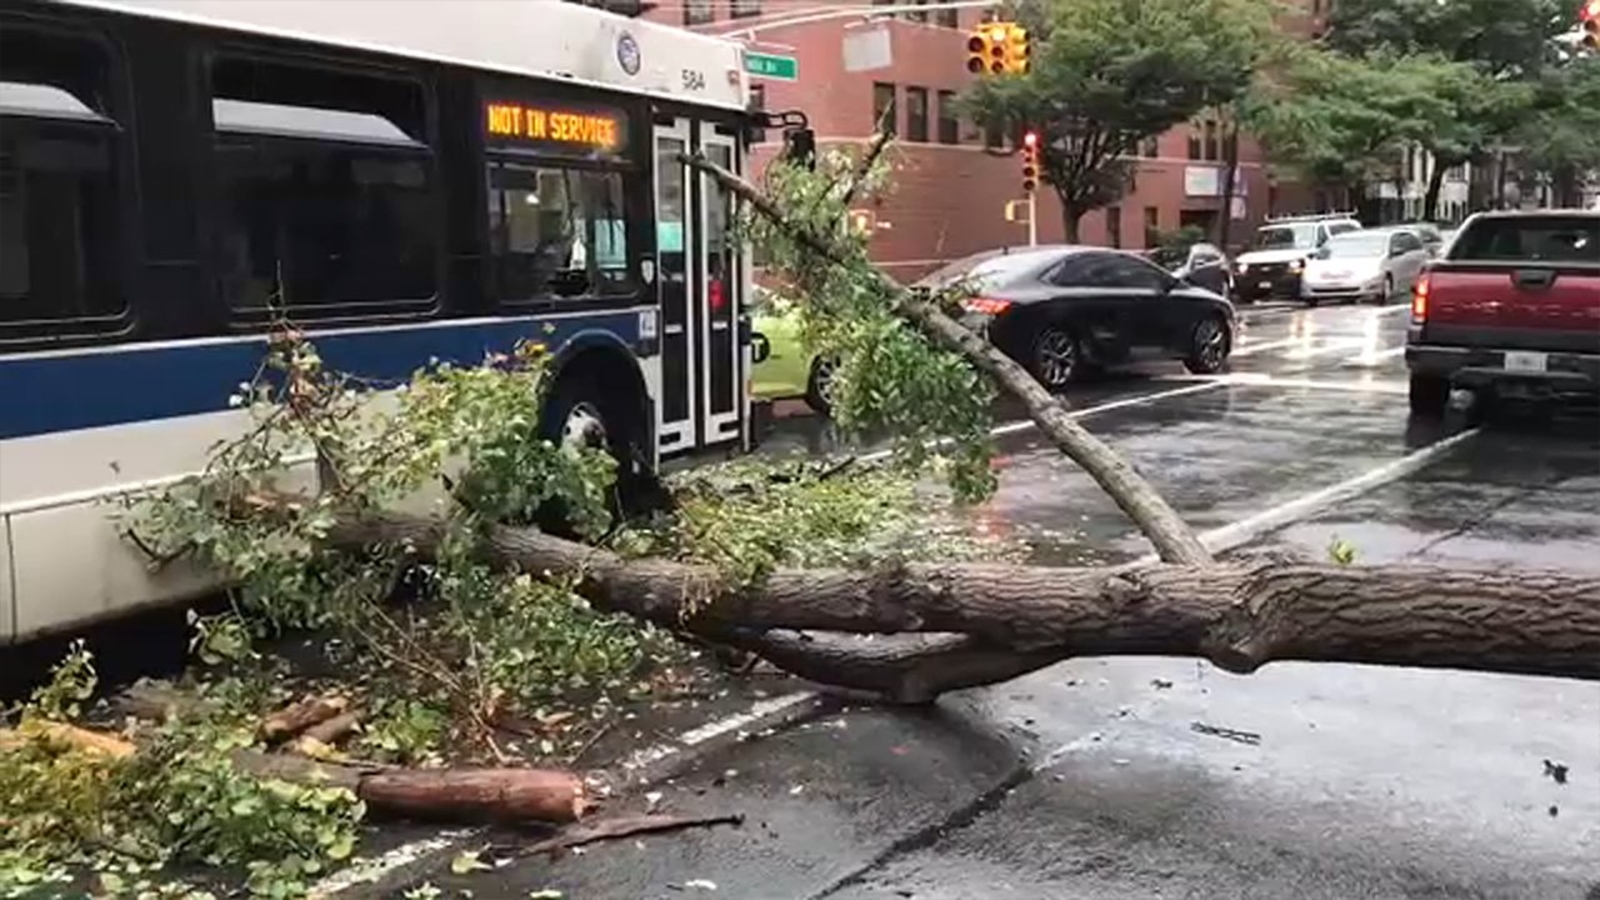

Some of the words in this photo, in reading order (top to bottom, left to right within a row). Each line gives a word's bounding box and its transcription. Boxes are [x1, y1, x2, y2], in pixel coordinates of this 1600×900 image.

[682, 68, 705, 90] 584
[488, 104, 521, 136] NOT
[526, 109, 546, 138] IN
[550, 112, 616, 145] SERVICE
